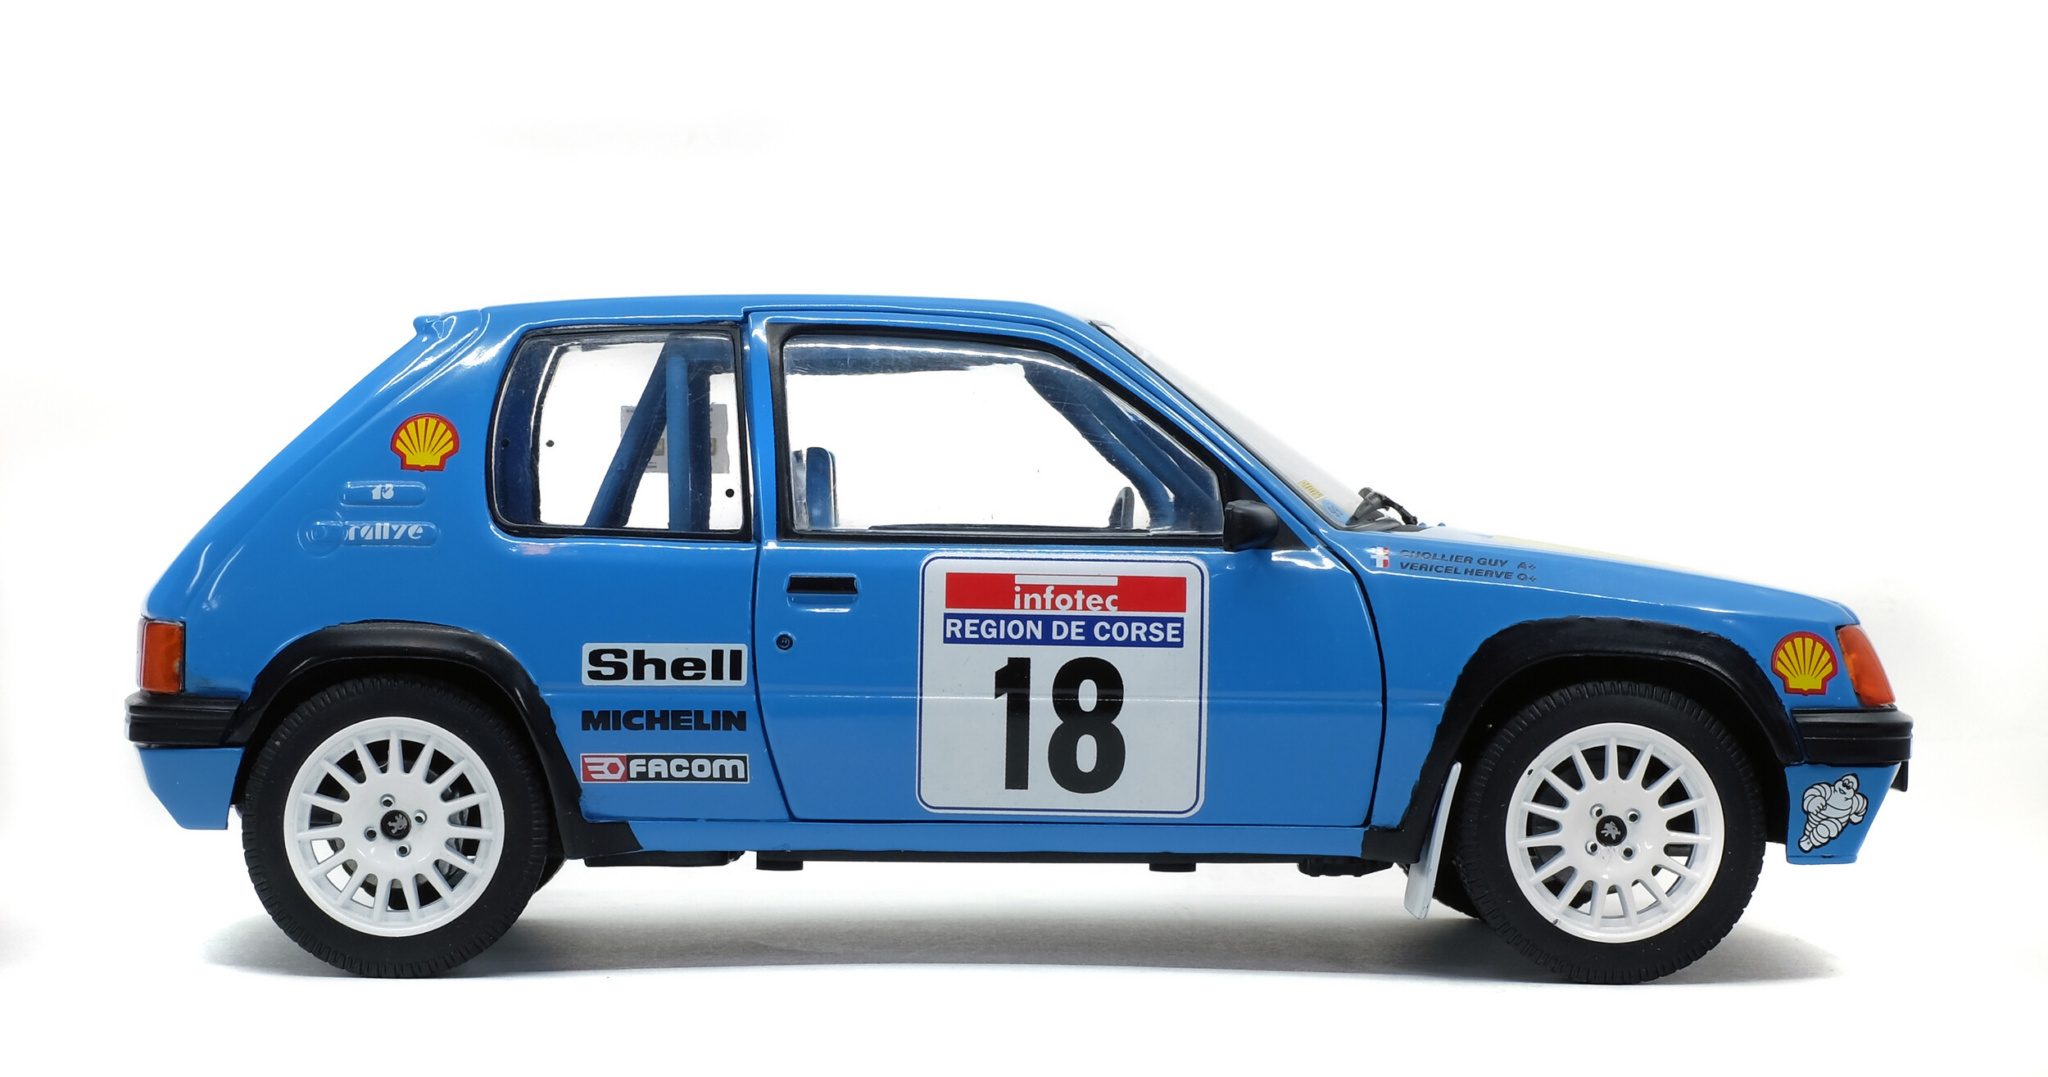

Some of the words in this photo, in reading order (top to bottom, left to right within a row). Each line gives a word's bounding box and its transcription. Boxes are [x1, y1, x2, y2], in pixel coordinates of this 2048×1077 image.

[348, 522, 424, 541] rallye
[1400, 561, 1462, 575] VERICEL
[1464, 567, 1514, 580] HERVE
[1477, 557, 1508, 567] GUY
[1013, 585, 1119, 612] infotec
[945, 618, 1043, 641] REGION
[1052, 620, 1086, 641] DE
[1094, 621, 1182, 643] CORSE
[587, 648, 743, 681] Shell
[581, 709, 747, 732] MICHELIN
[993, 656, 1127, 795] 18
[629, 757, 746, 779] FACOM
